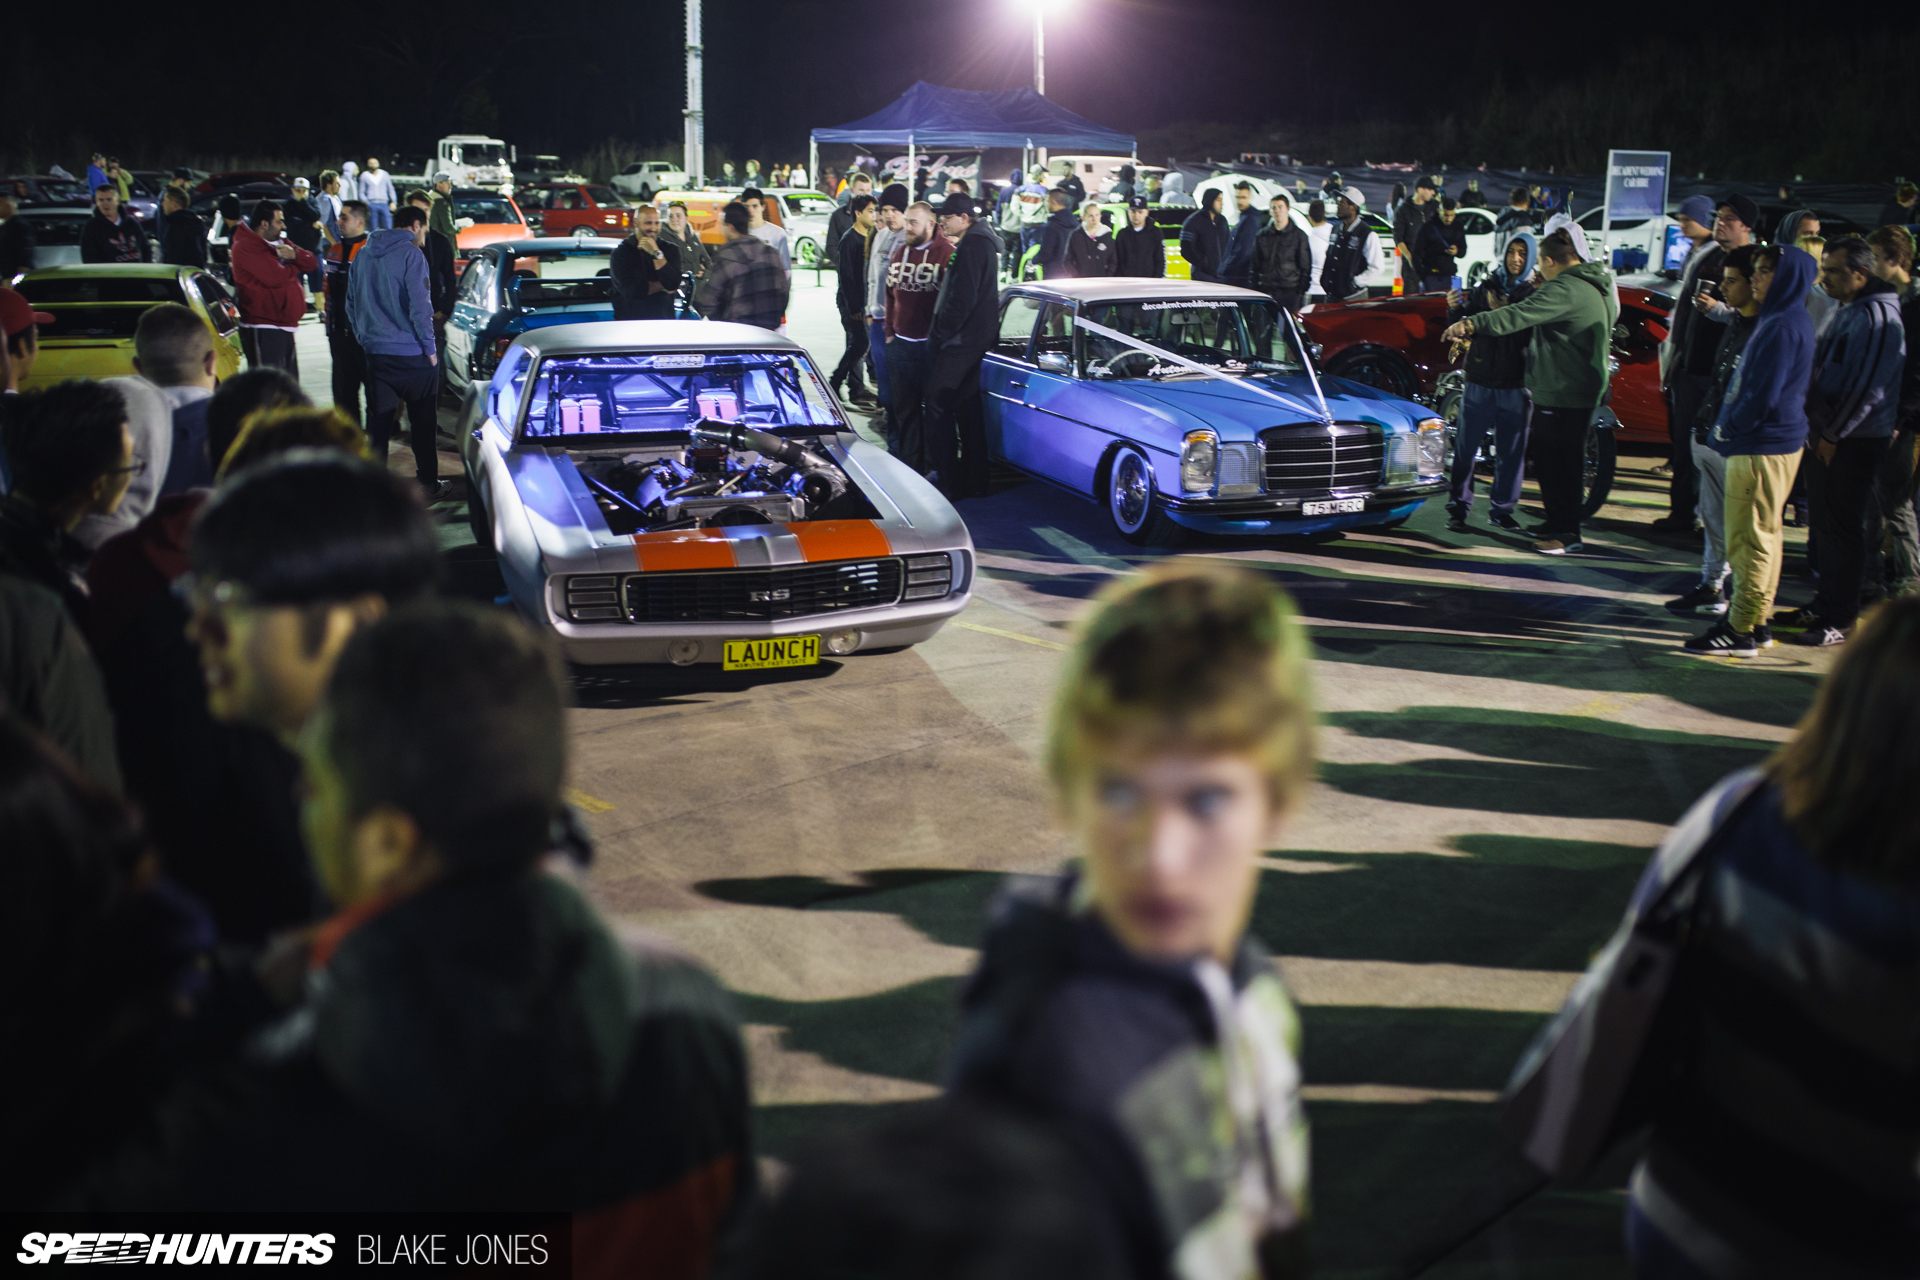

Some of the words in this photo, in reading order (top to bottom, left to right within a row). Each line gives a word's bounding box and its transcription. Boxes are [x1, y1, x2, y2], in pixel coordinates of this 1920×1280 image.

[1141, 300, 1239, 311] decadentweddings.com
[750, 588, 790, 601] RS
[728, 639, 815, 663] LAUNCH
